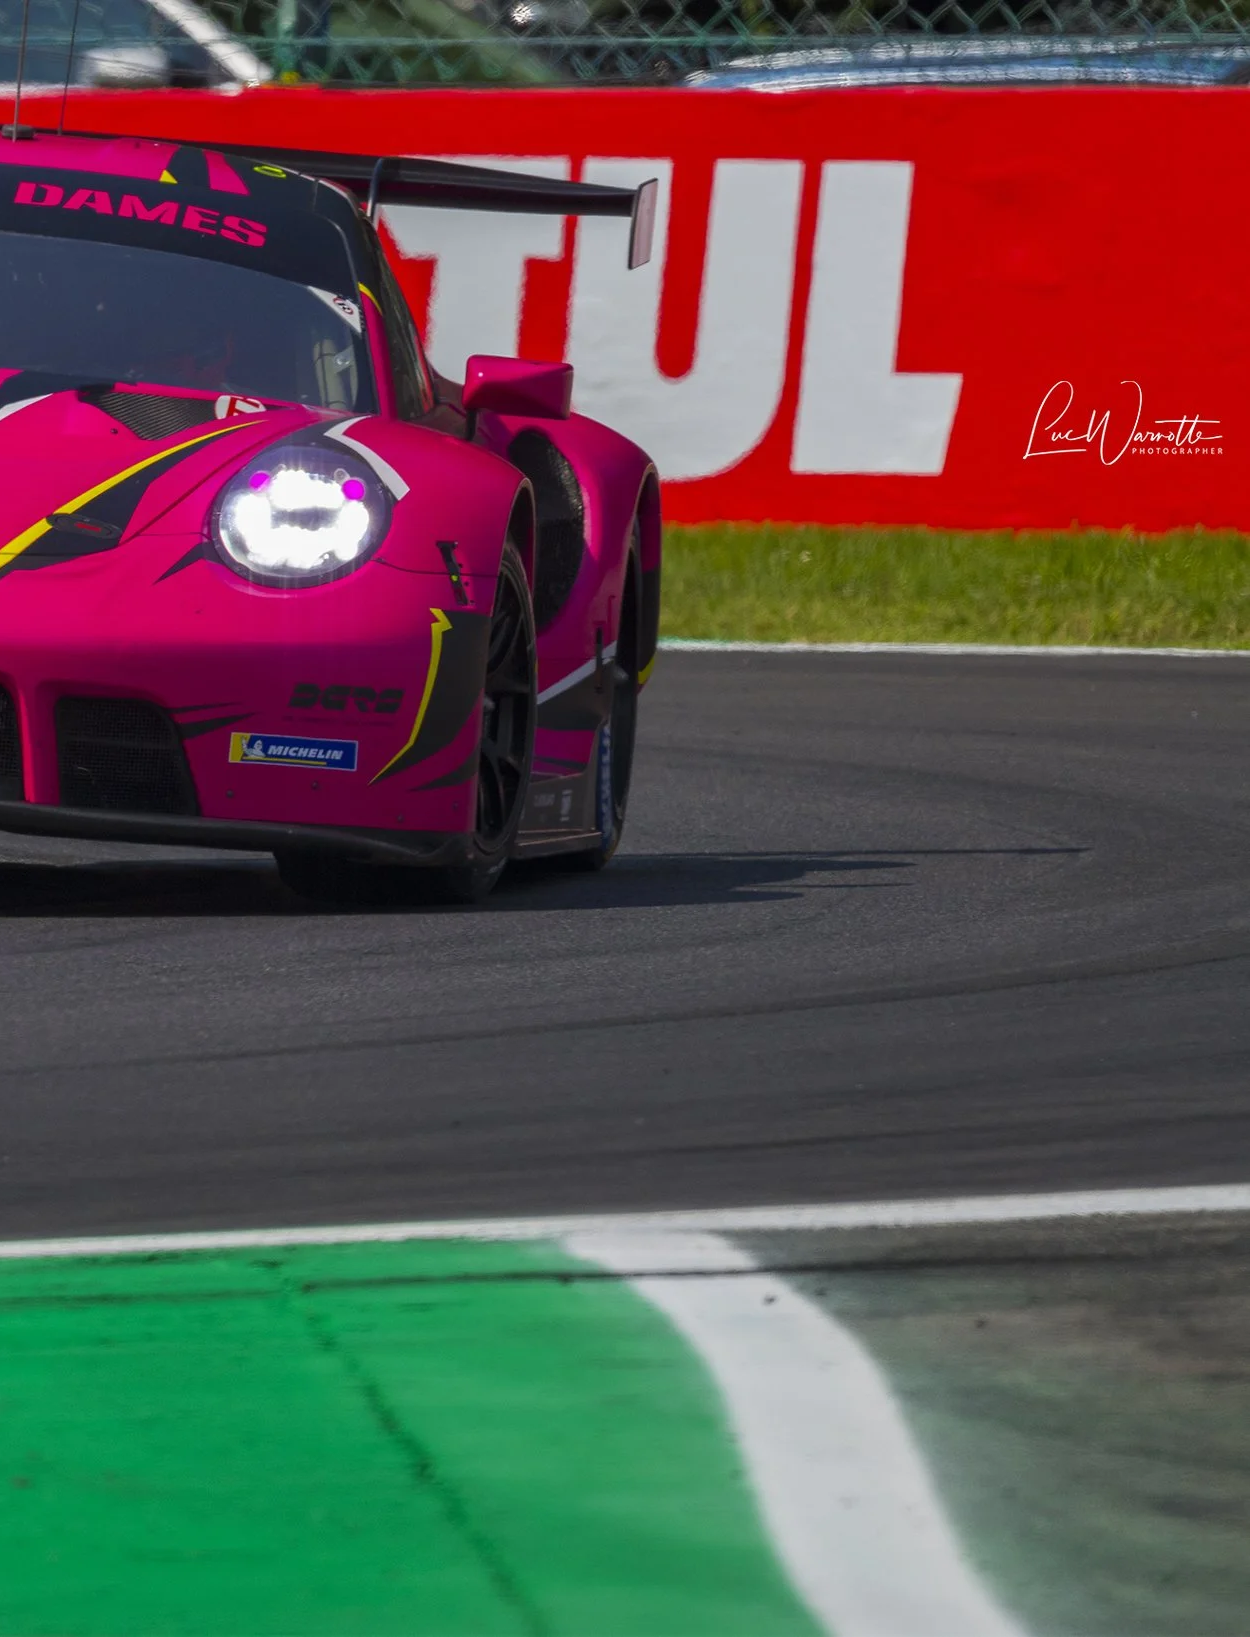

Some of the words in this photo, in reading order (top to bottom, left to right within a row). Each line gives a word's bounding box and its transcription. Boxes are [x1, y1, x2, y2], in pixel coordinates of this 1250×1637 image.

[14, 182, 268, 248] DAMES
[374, 154, 963, 483] TUL
[267, 744, 345, 761] MICHELIN
